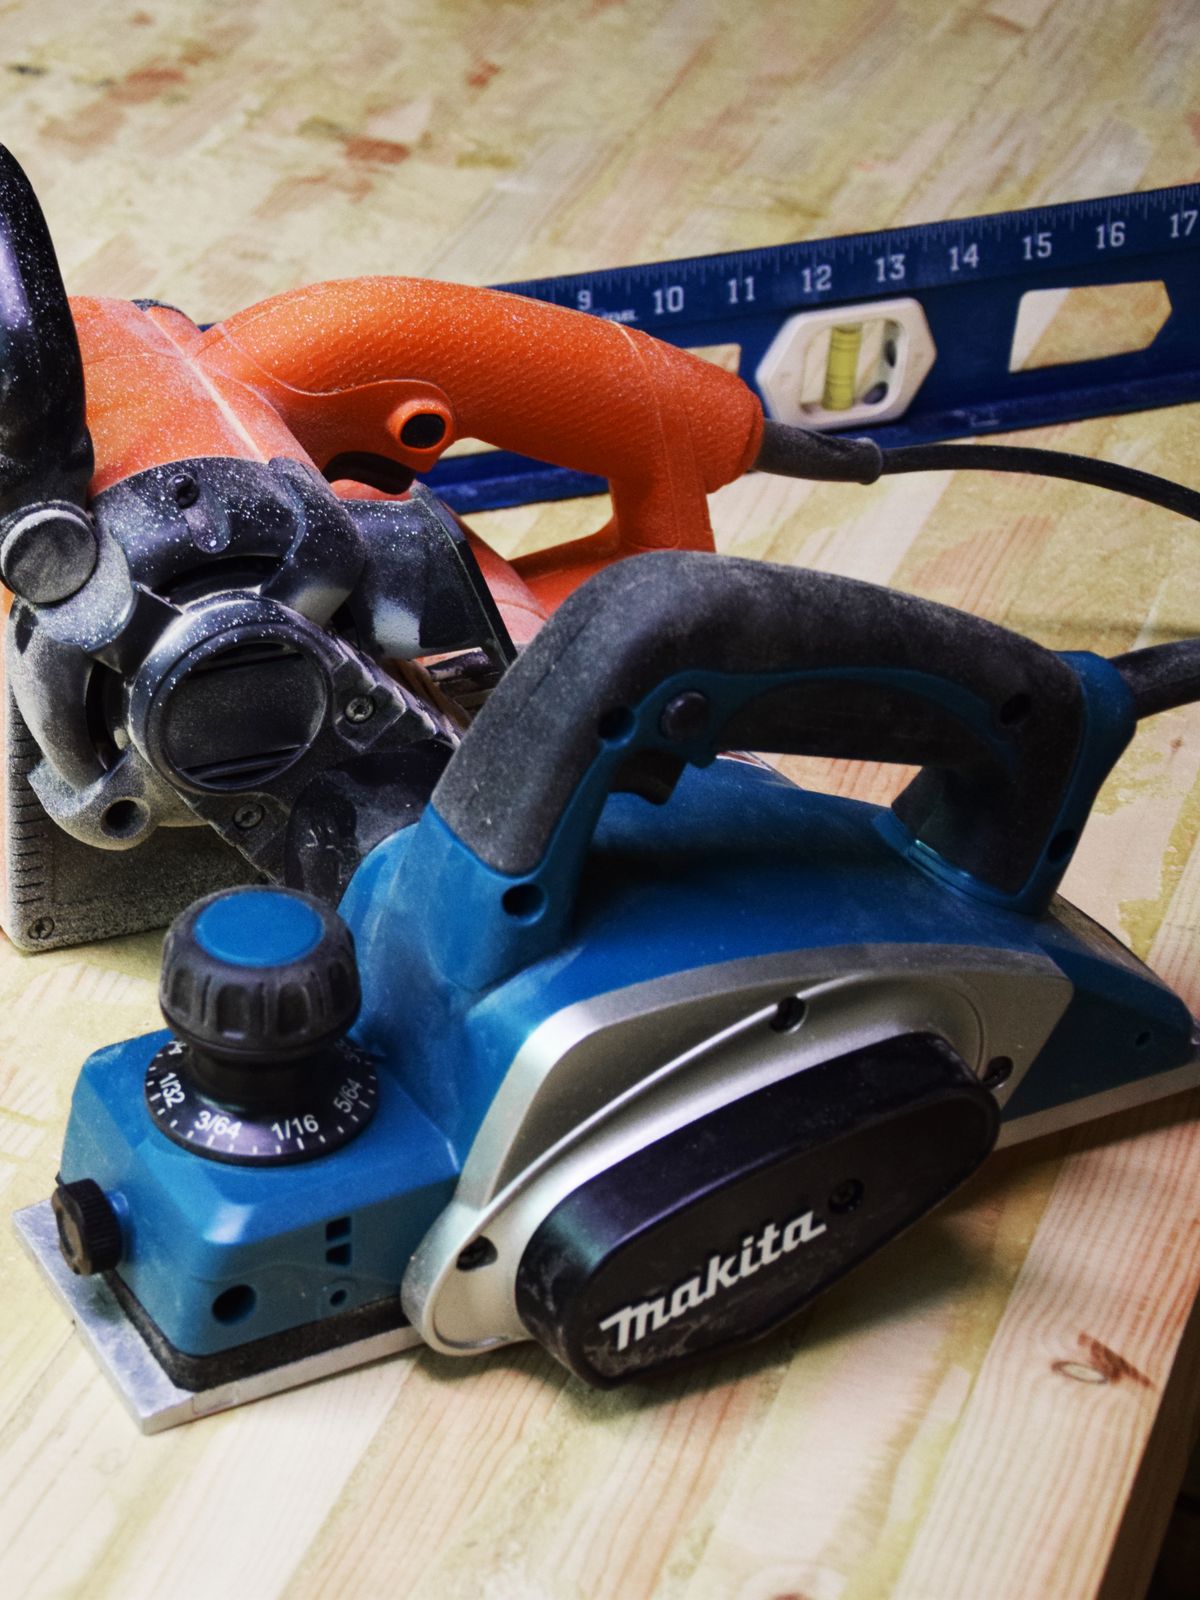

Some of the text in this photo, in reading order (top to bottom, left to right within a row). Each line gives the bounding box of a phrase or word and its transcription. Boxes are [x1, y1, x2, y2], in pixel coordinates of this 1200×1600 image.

[577, 209, 1198, 314] 9 10 11 12 13 14 15 16 17
[159, 1072, 363, 1141] 1/32 3/64 1/16 5/64
[600, 1210, 826, 1351] makita
